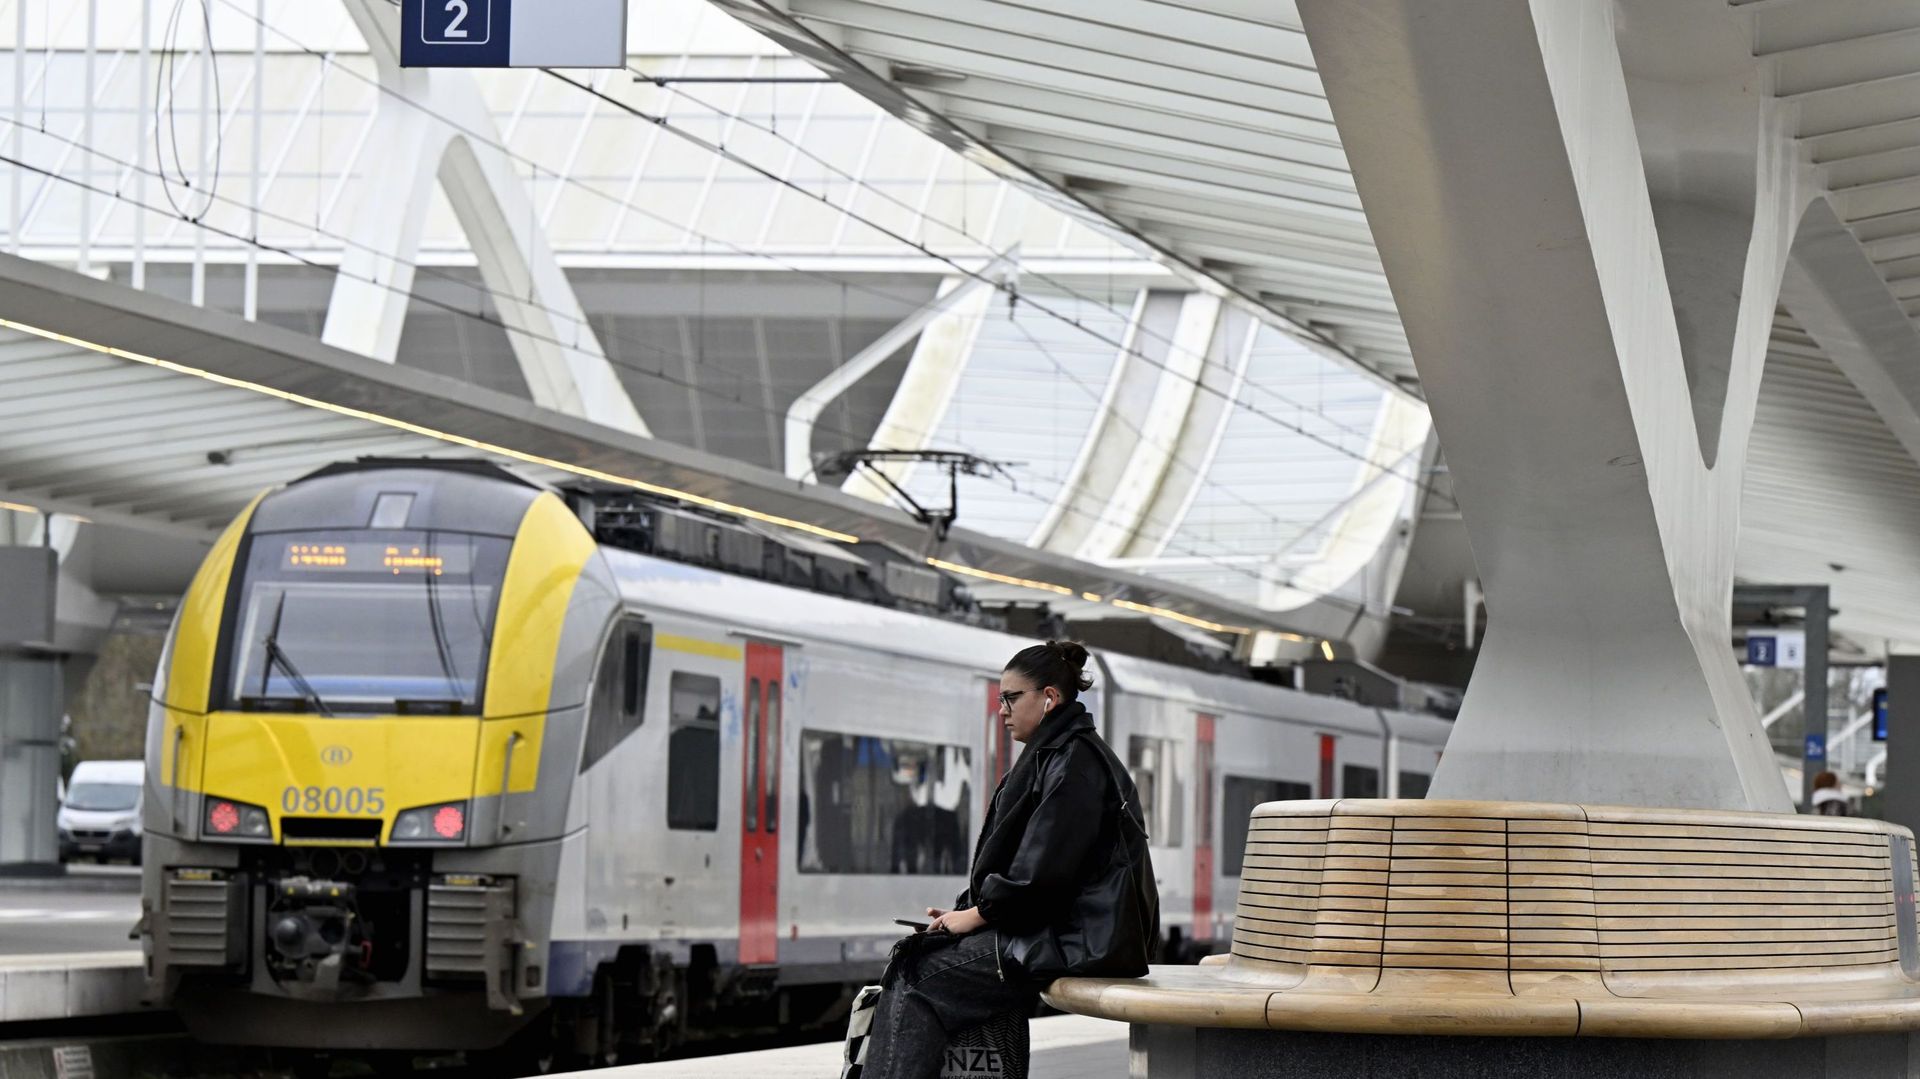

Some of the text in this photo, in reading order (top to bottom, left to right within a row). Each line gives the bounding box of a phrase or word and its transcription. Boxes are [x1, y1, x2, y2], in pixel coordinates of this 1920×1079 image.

[444, 0, 468, 38] 2
[282, 786, 385, 815] 08005
[942, 1049, 1001, 1072] NZE
